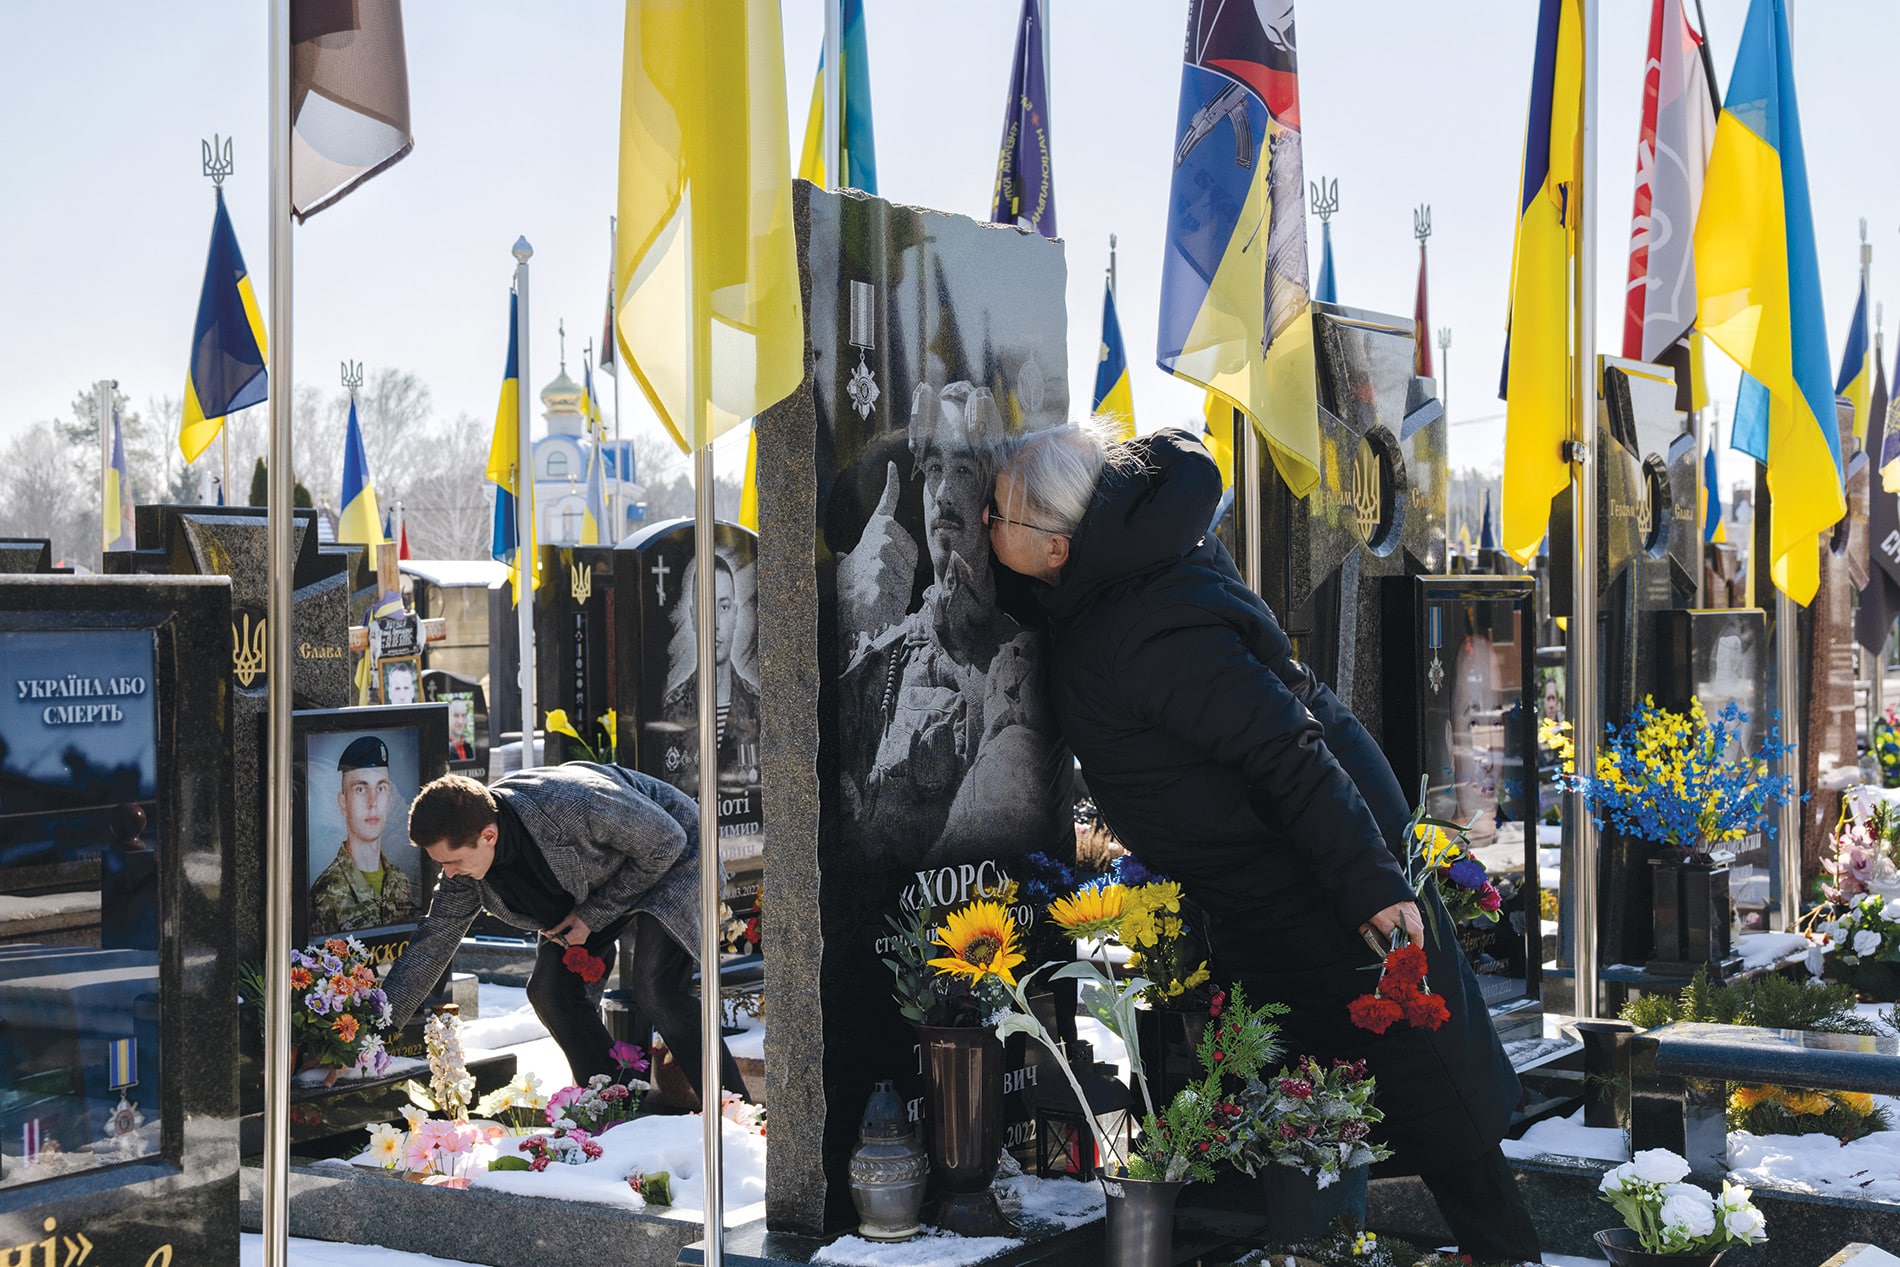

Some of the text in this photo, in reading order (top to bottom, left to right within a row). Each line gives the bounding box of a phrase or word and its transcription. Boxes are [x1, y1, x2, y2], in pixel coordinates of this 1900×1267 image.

[299, 642, 343, 660] Слава
[17, 674, 147, 699] УКРАЇНА АБО
[42, 703, 124, 725] СМЕРТЬ
[900, 859, 1010, 912] «ХОРС»
